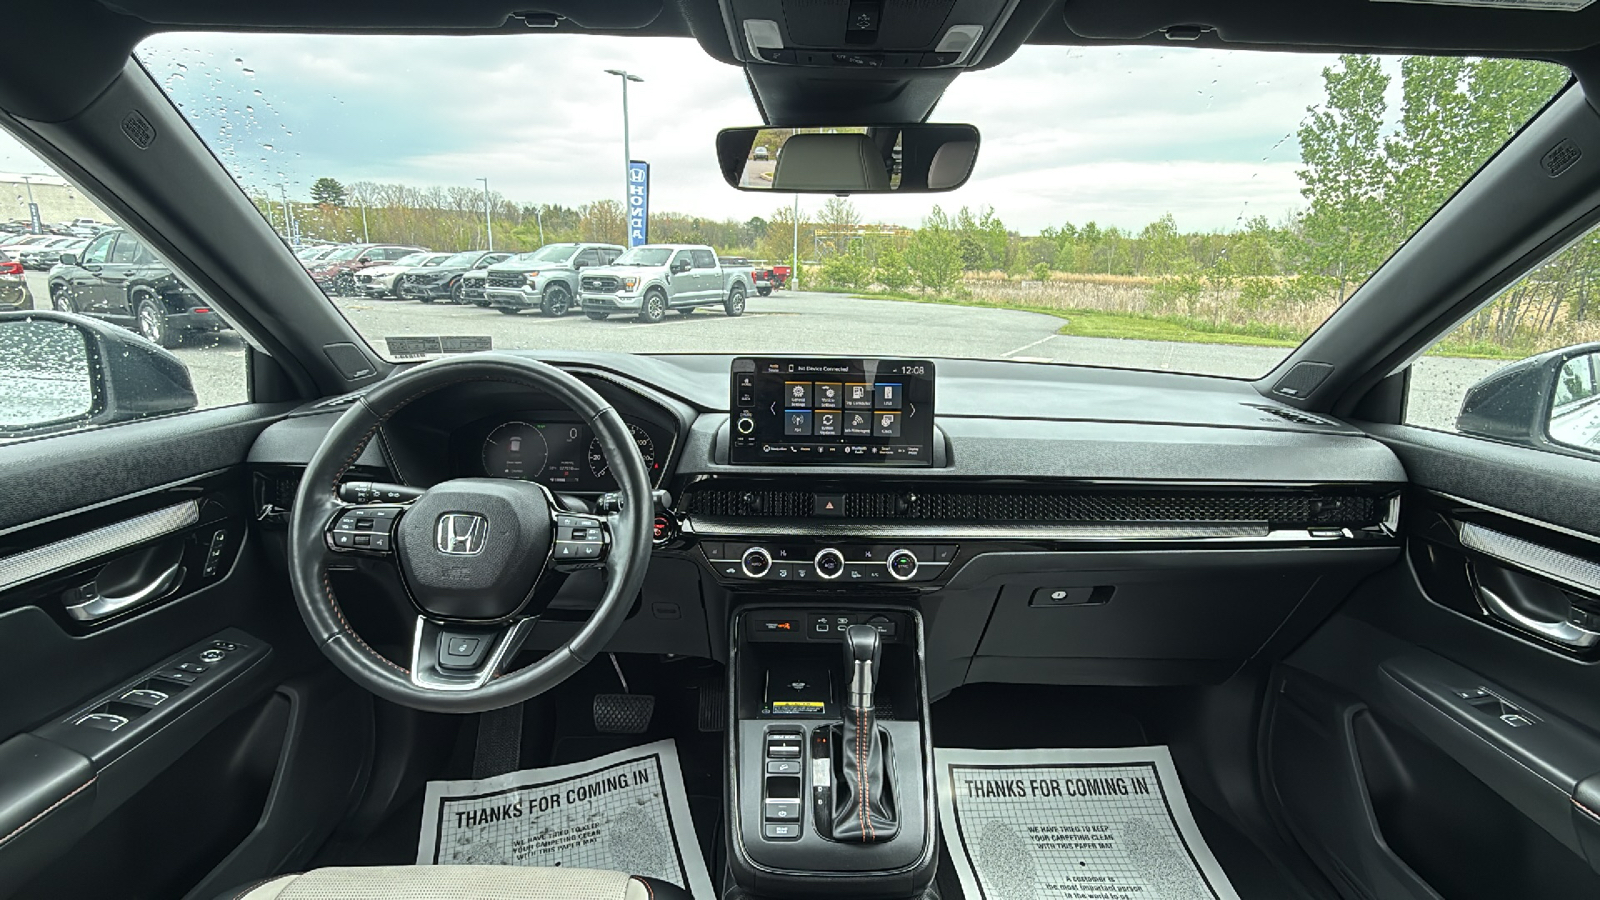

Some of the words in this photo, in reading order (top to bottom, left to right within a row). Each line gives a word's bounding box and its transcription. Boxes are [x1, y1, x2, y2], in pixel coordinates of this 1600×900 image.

[902, 366, 924, 374] 12:08
[570, 428, 578, 438] 0
[965, 779, 1026, 798] THANKS
[1030, 779, 1062, 797] FOR
[1066, 777, 1128, 796] COMING
[1131, 777, 1150, 795] IN
[456, 802, 523, 828] THANKS
[529, 794, 561, 814] FOR
[566, 774, 629, 804] COMING
[632, 768, 650, 786] IN
[528, 834, 546, 843] HAVE
[1030, 834, 1050, 842] YOUR
[513, 844, 534, 853] YOUR
[516, 851, 536, 860] WITH
[540, 846, 555, 854] THIS
[558, 842, 580, 850] PAPER
[582, 838, 598, 846] MAT
[1036, 842, 1056, 850] WITH
[1057, 842, 1074, 850] THIS
